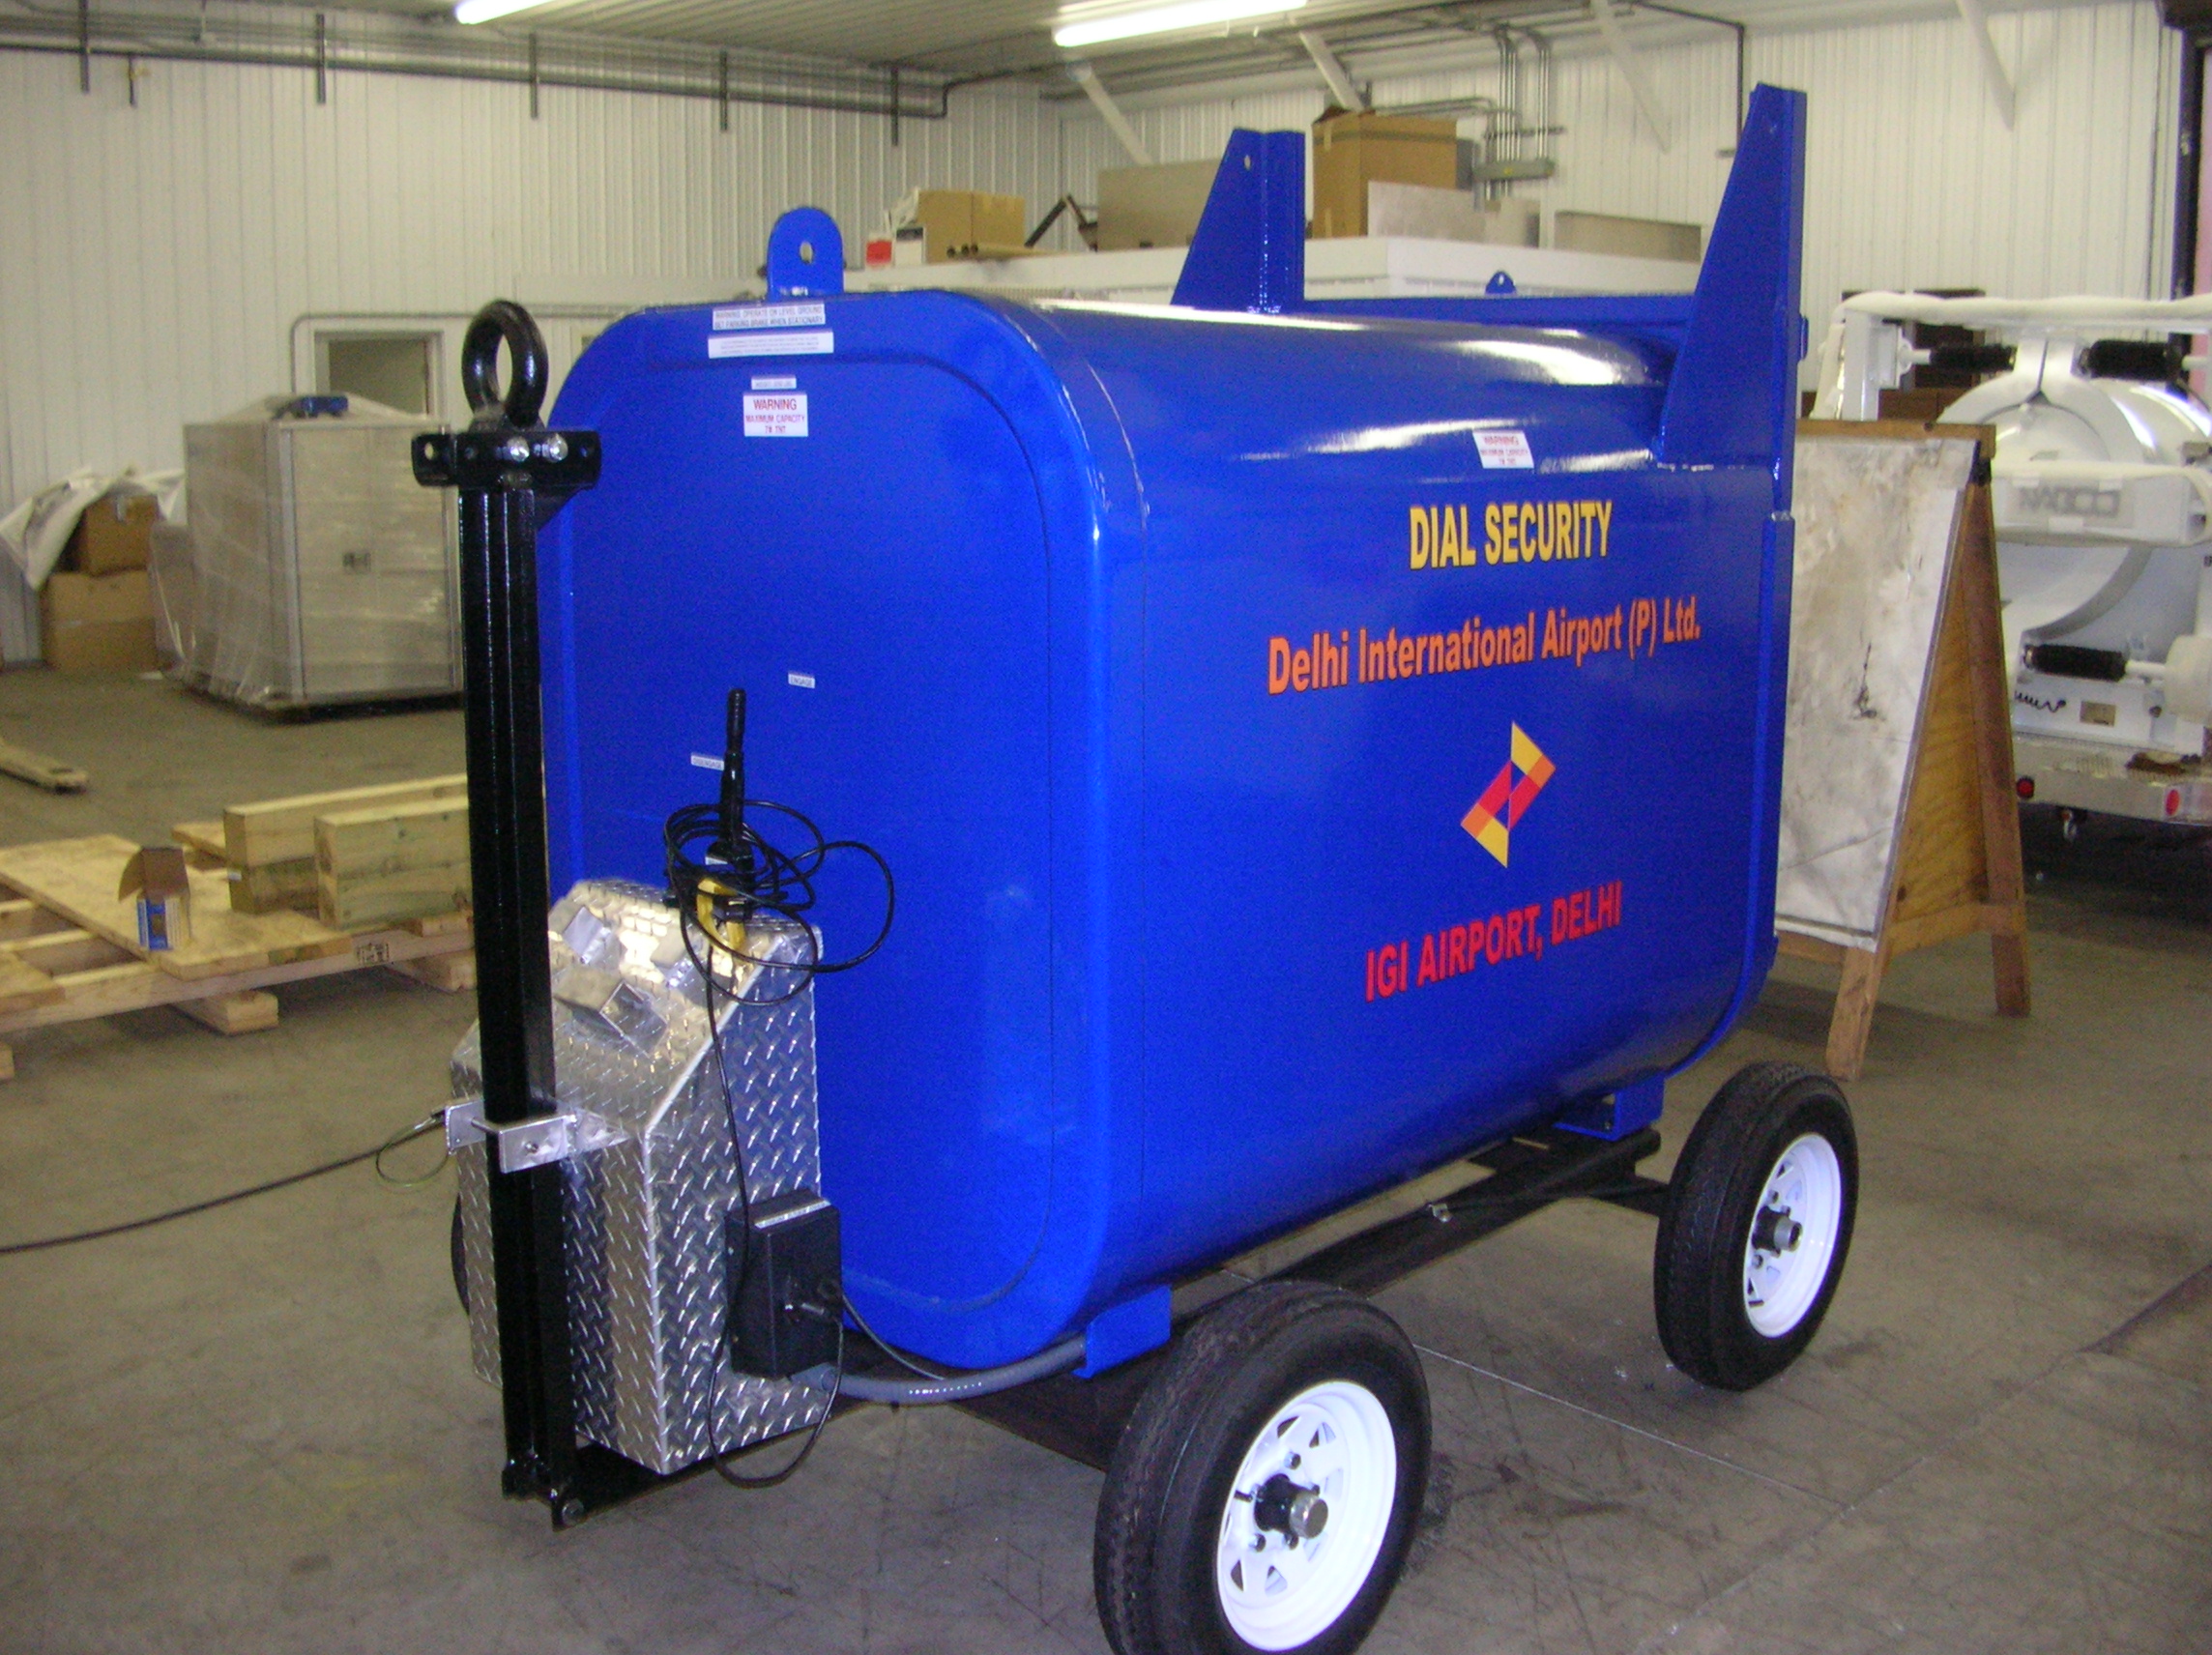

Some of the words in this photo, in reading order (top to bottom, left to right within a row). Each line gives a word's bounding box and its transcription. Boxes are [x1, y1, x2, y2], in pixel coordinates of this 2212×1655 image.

[753, 398, 797, 410] WARNING
[776, 414, 804, 422] CAPACITY
[1410, 505, 1476, 570] DIAL
[1484, 499, 1613, 566] SECURITY
[1266, 629, 1350, 695] Delhi
[1358, 611, 1535, 682] International
[1540, 603, 1623, 667] Airport
[1628, 596, 1657, 660] (P)
[1663, 595, 1702, 644] Ltd.
[1365, 940, 1409, 1003] IGI
[1415, 903, 1544, 988] AIRPORT,
[1550, 880, 1622, 946] DELHI
